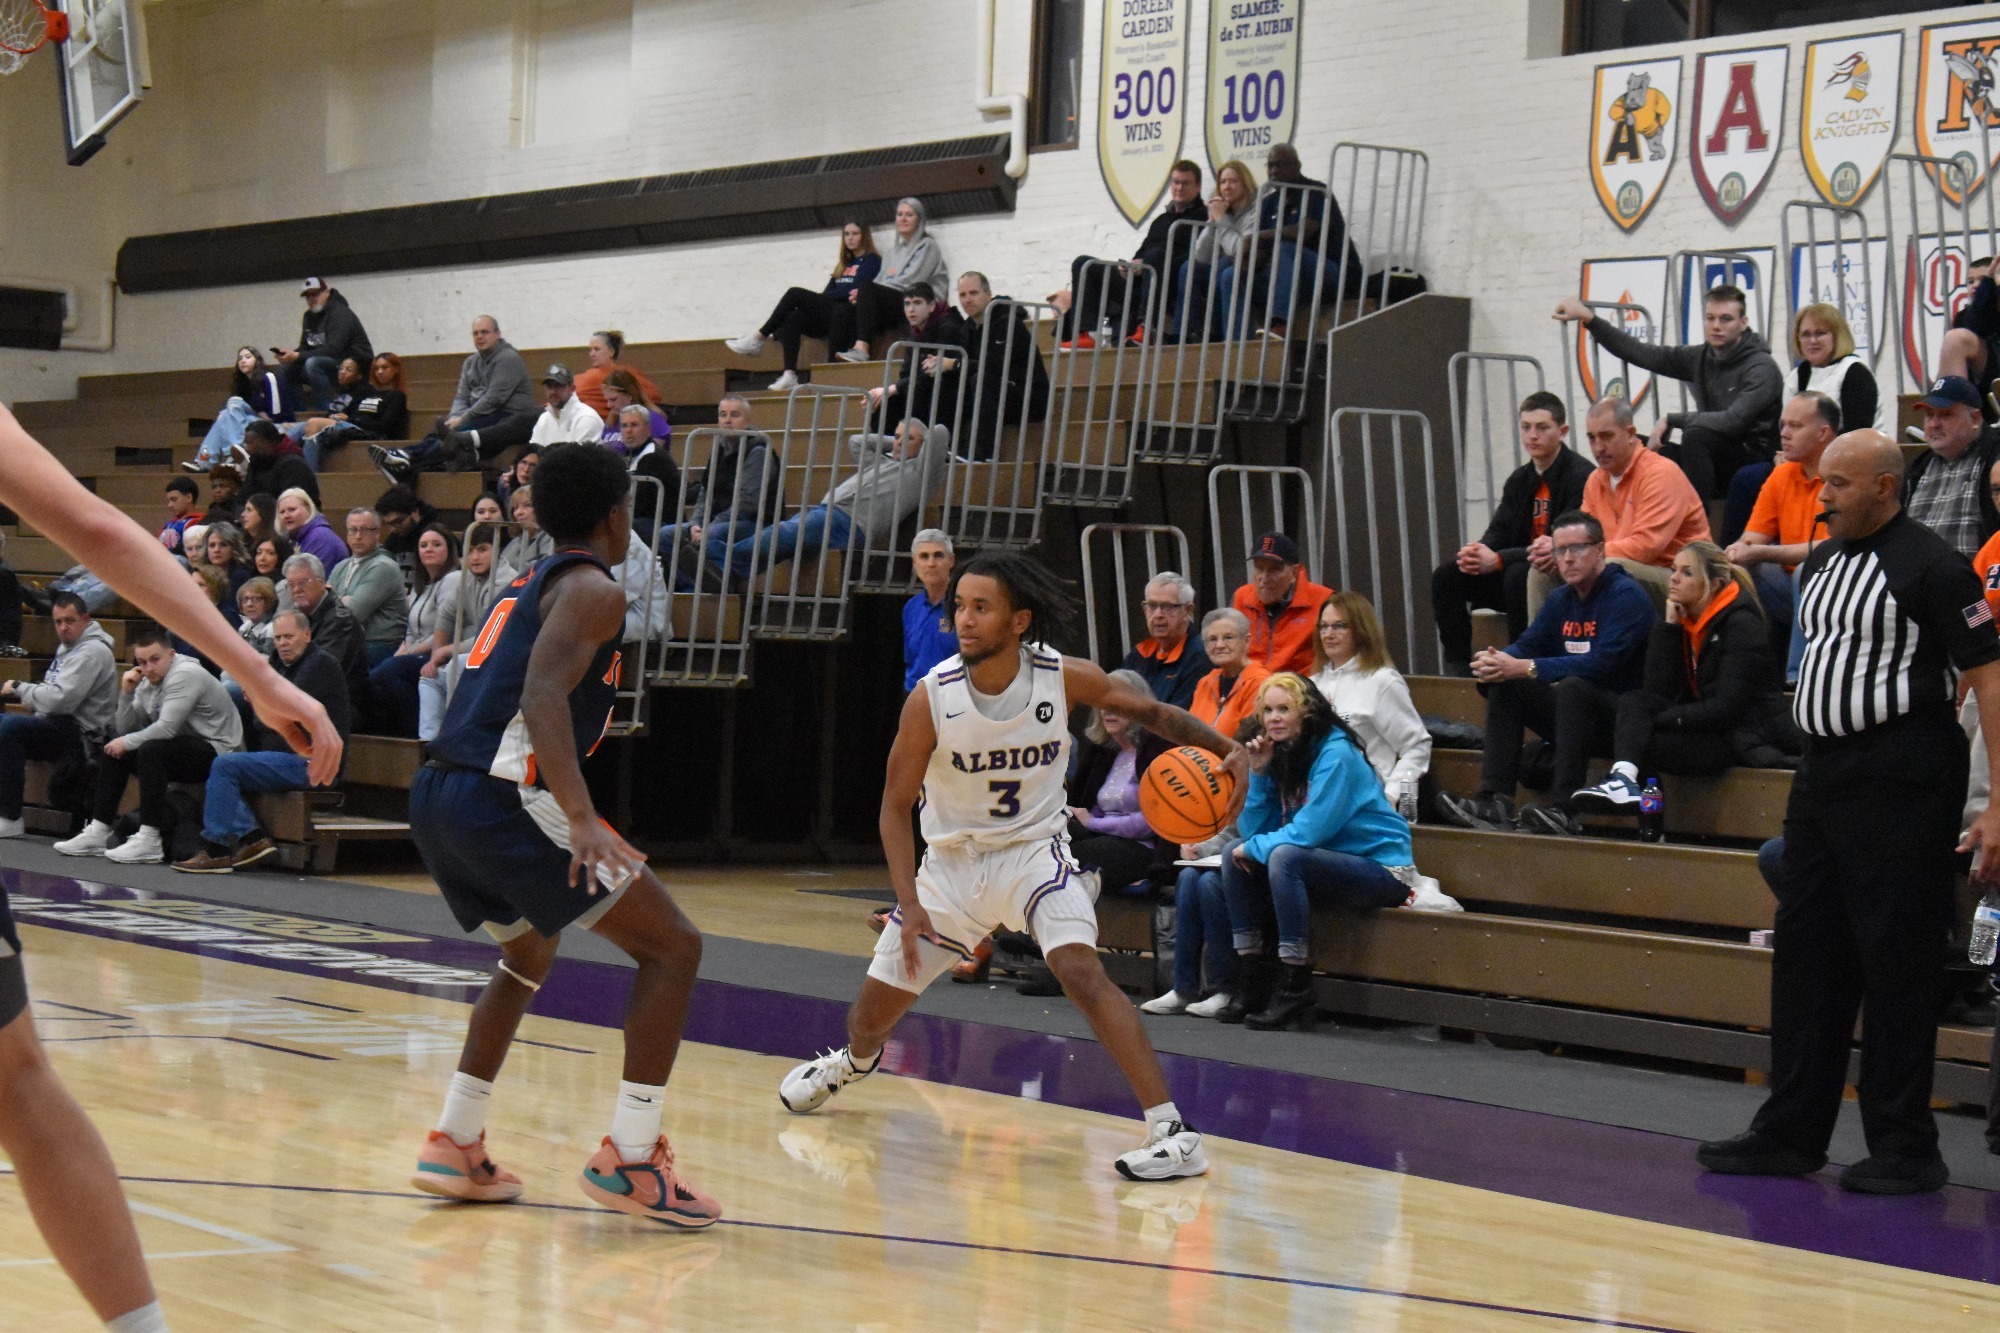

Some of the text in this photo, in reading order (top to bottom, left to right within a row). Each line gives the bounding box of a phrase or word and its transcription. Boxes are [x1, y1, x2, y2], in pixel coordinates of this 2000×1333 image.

[1123, 0, 1174, 17] DOREEN
[1231, 0, 1285, 19] SLAMER-
[1122, 15, 1174, 38] CARDEN
[1220, 17, 1294, 42] de ST. AUBIN
[1114, 66, 1176, 120] 300
[1223, 69, 1285, 125] 100
[1705, 61, 1769, 157] A
[1825, 107, 1883, 124] CALVIN
[1125, 121, 1162, 143] WINS
[1232, 126, 1271, 148] WINS
[1602, 118, 1643, 166] A
[1813, 121, 1891, 140] KNIGHTS
[1562, 620, 1597, 637] HOPE
[1039, 705, 1053, 720] ZW
[951, 740, 1061, 774] ALBION
[1179, 746, 1221, 796] Wilson
[988, 779, 1021, 818] 3
